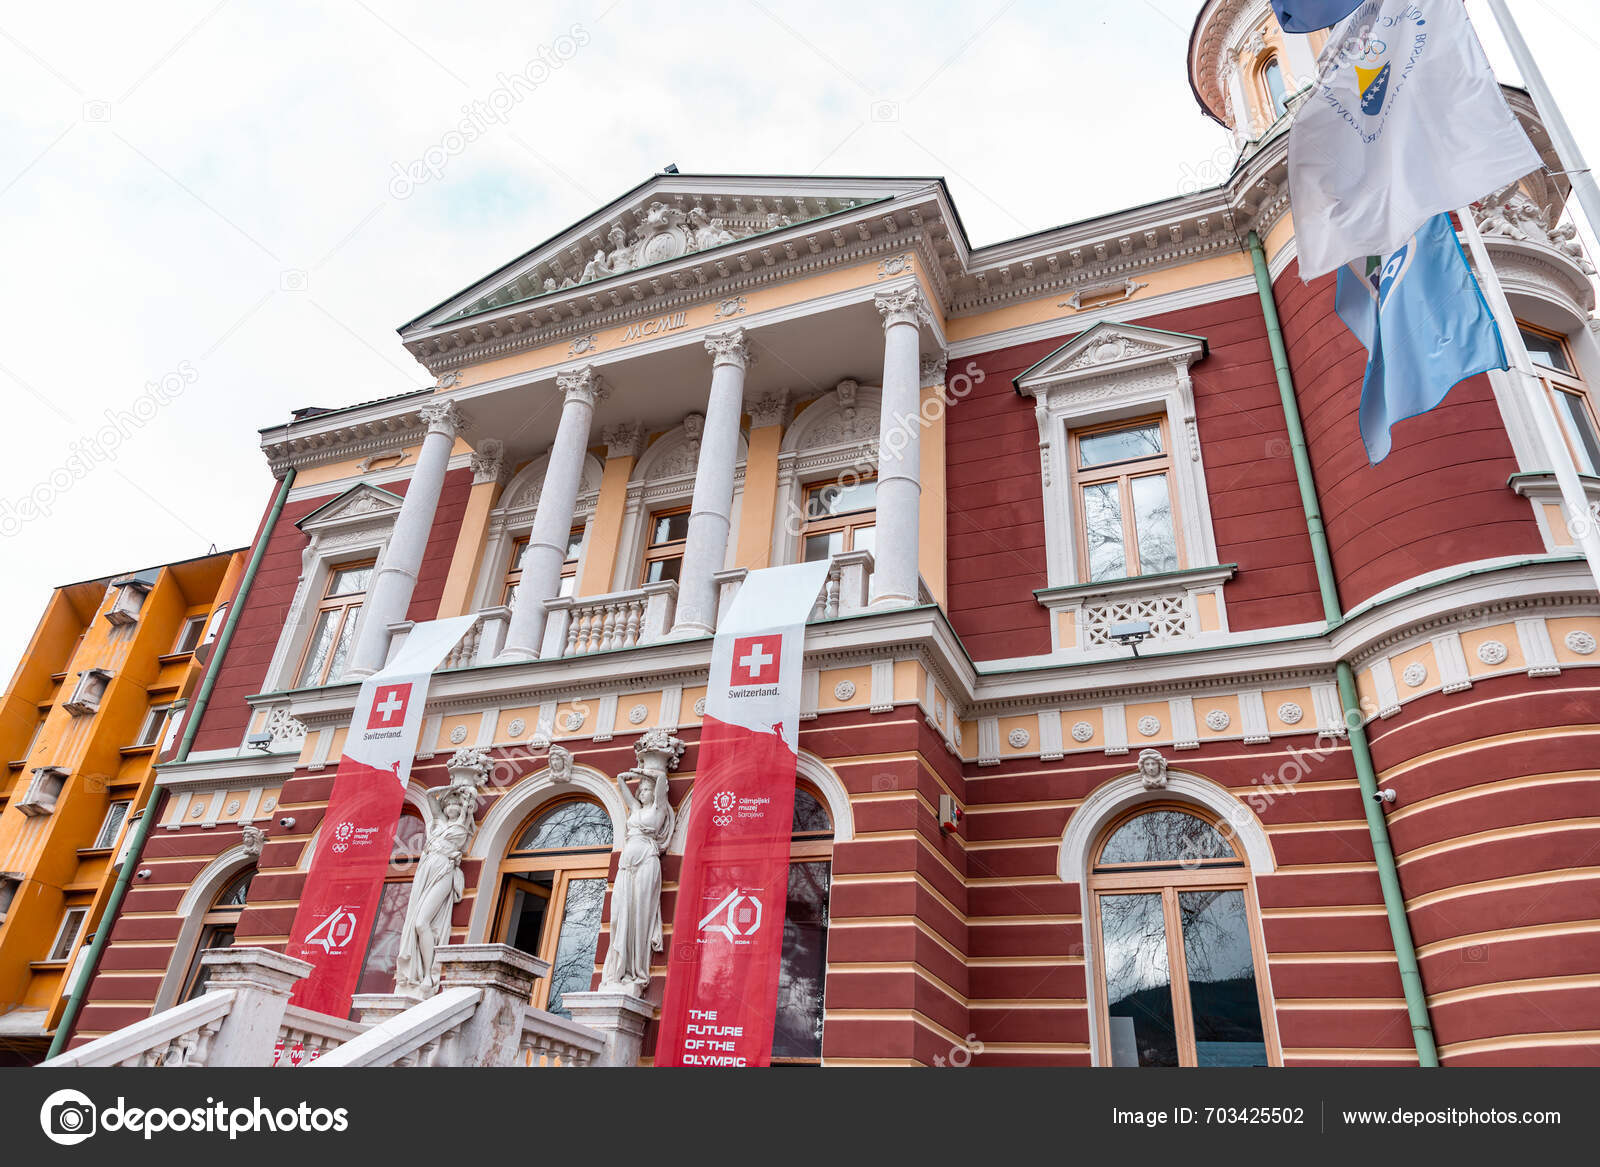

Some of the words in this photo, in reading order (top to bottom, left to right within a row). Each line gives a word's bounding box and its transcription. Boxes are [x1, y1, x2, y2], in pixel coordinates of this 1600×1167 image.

[621, 311, 688, 342] MCMIII
[728, 687, 781, 699] Switzerland.
[363, 730, 403, 741] Switzerland.
[688, 1009, 718, 1021] THE
[686, 1024, 744, 1037] FUTURE
[684, 1039, 705, 1050] OF
[706, 1040, 736, 1052] THE
[682, 1054, 747, 1068] OLYMPIC
